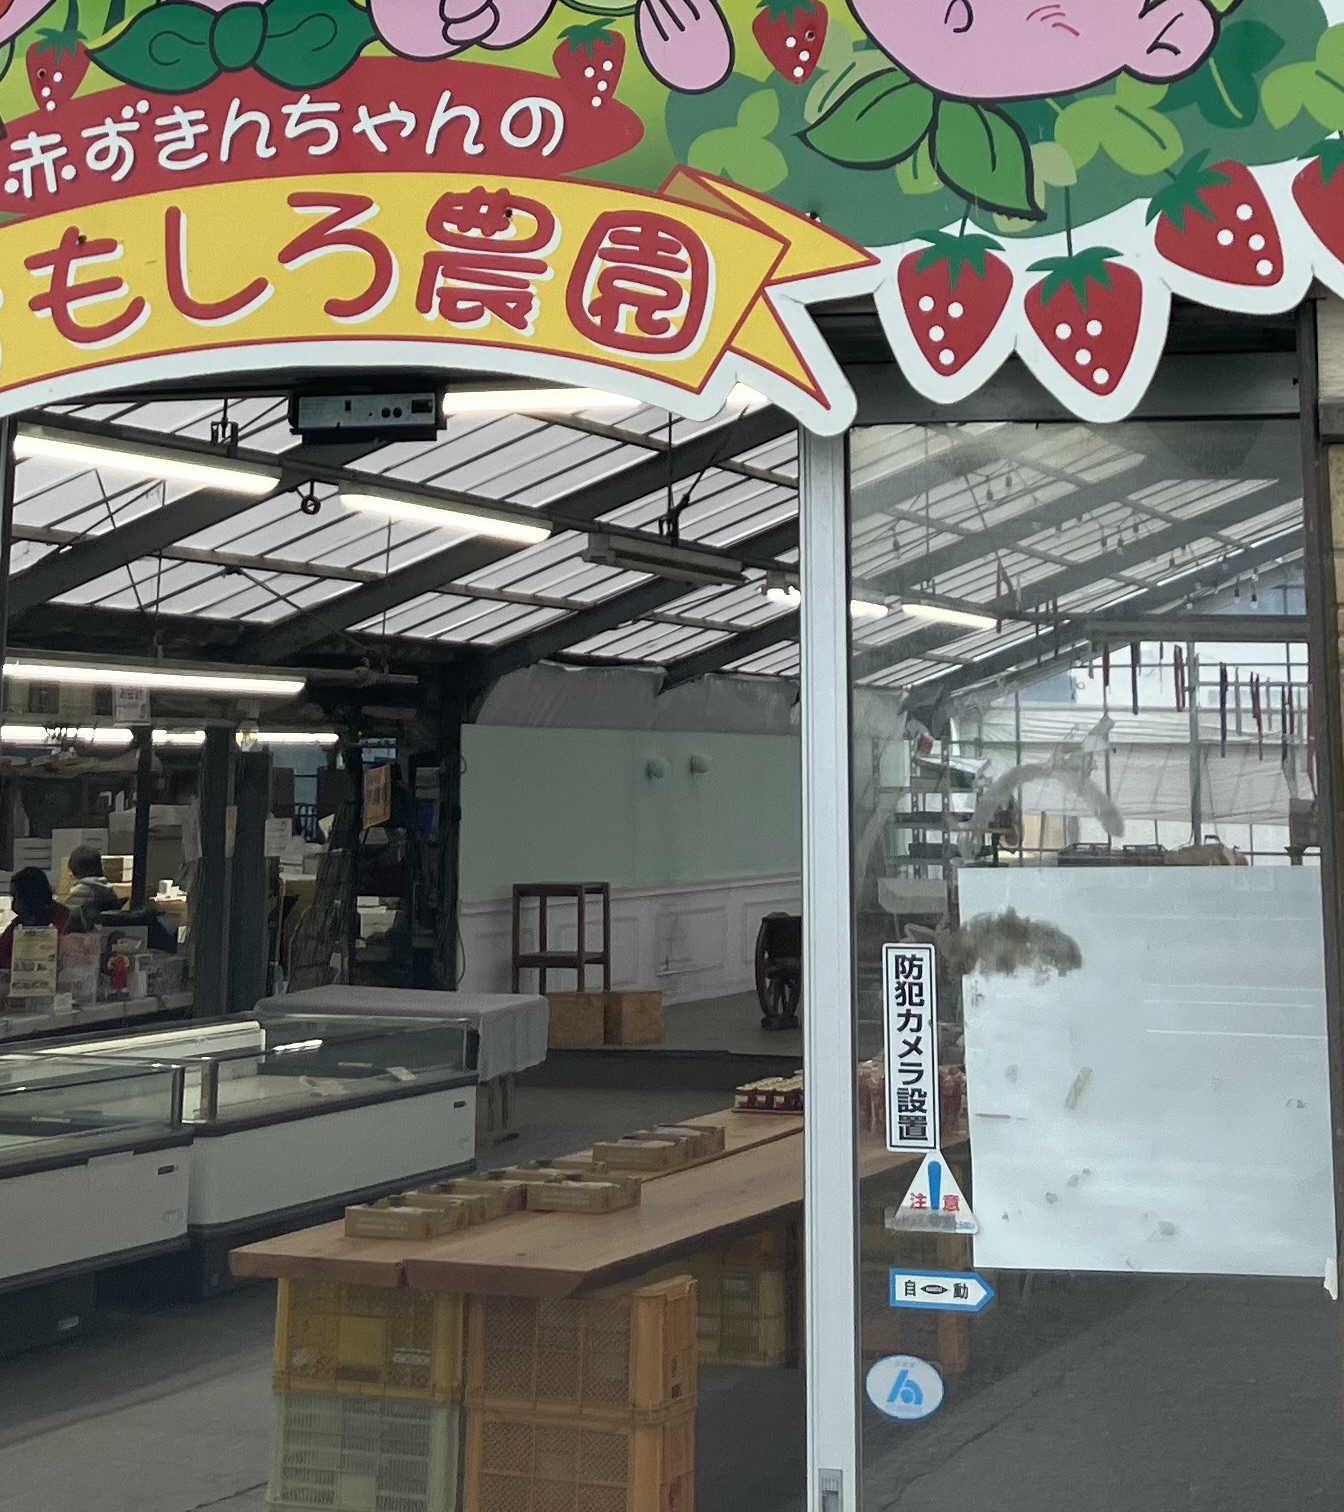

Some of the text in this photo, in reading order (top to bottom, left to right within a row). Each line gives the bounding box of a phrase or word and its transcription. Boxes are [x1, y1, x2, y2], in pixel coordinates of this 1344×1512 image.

[2, 90, 566, 199] 赤ずきんちゃんの
[894, 953, 928, 1141] 防犯カメラ設置
